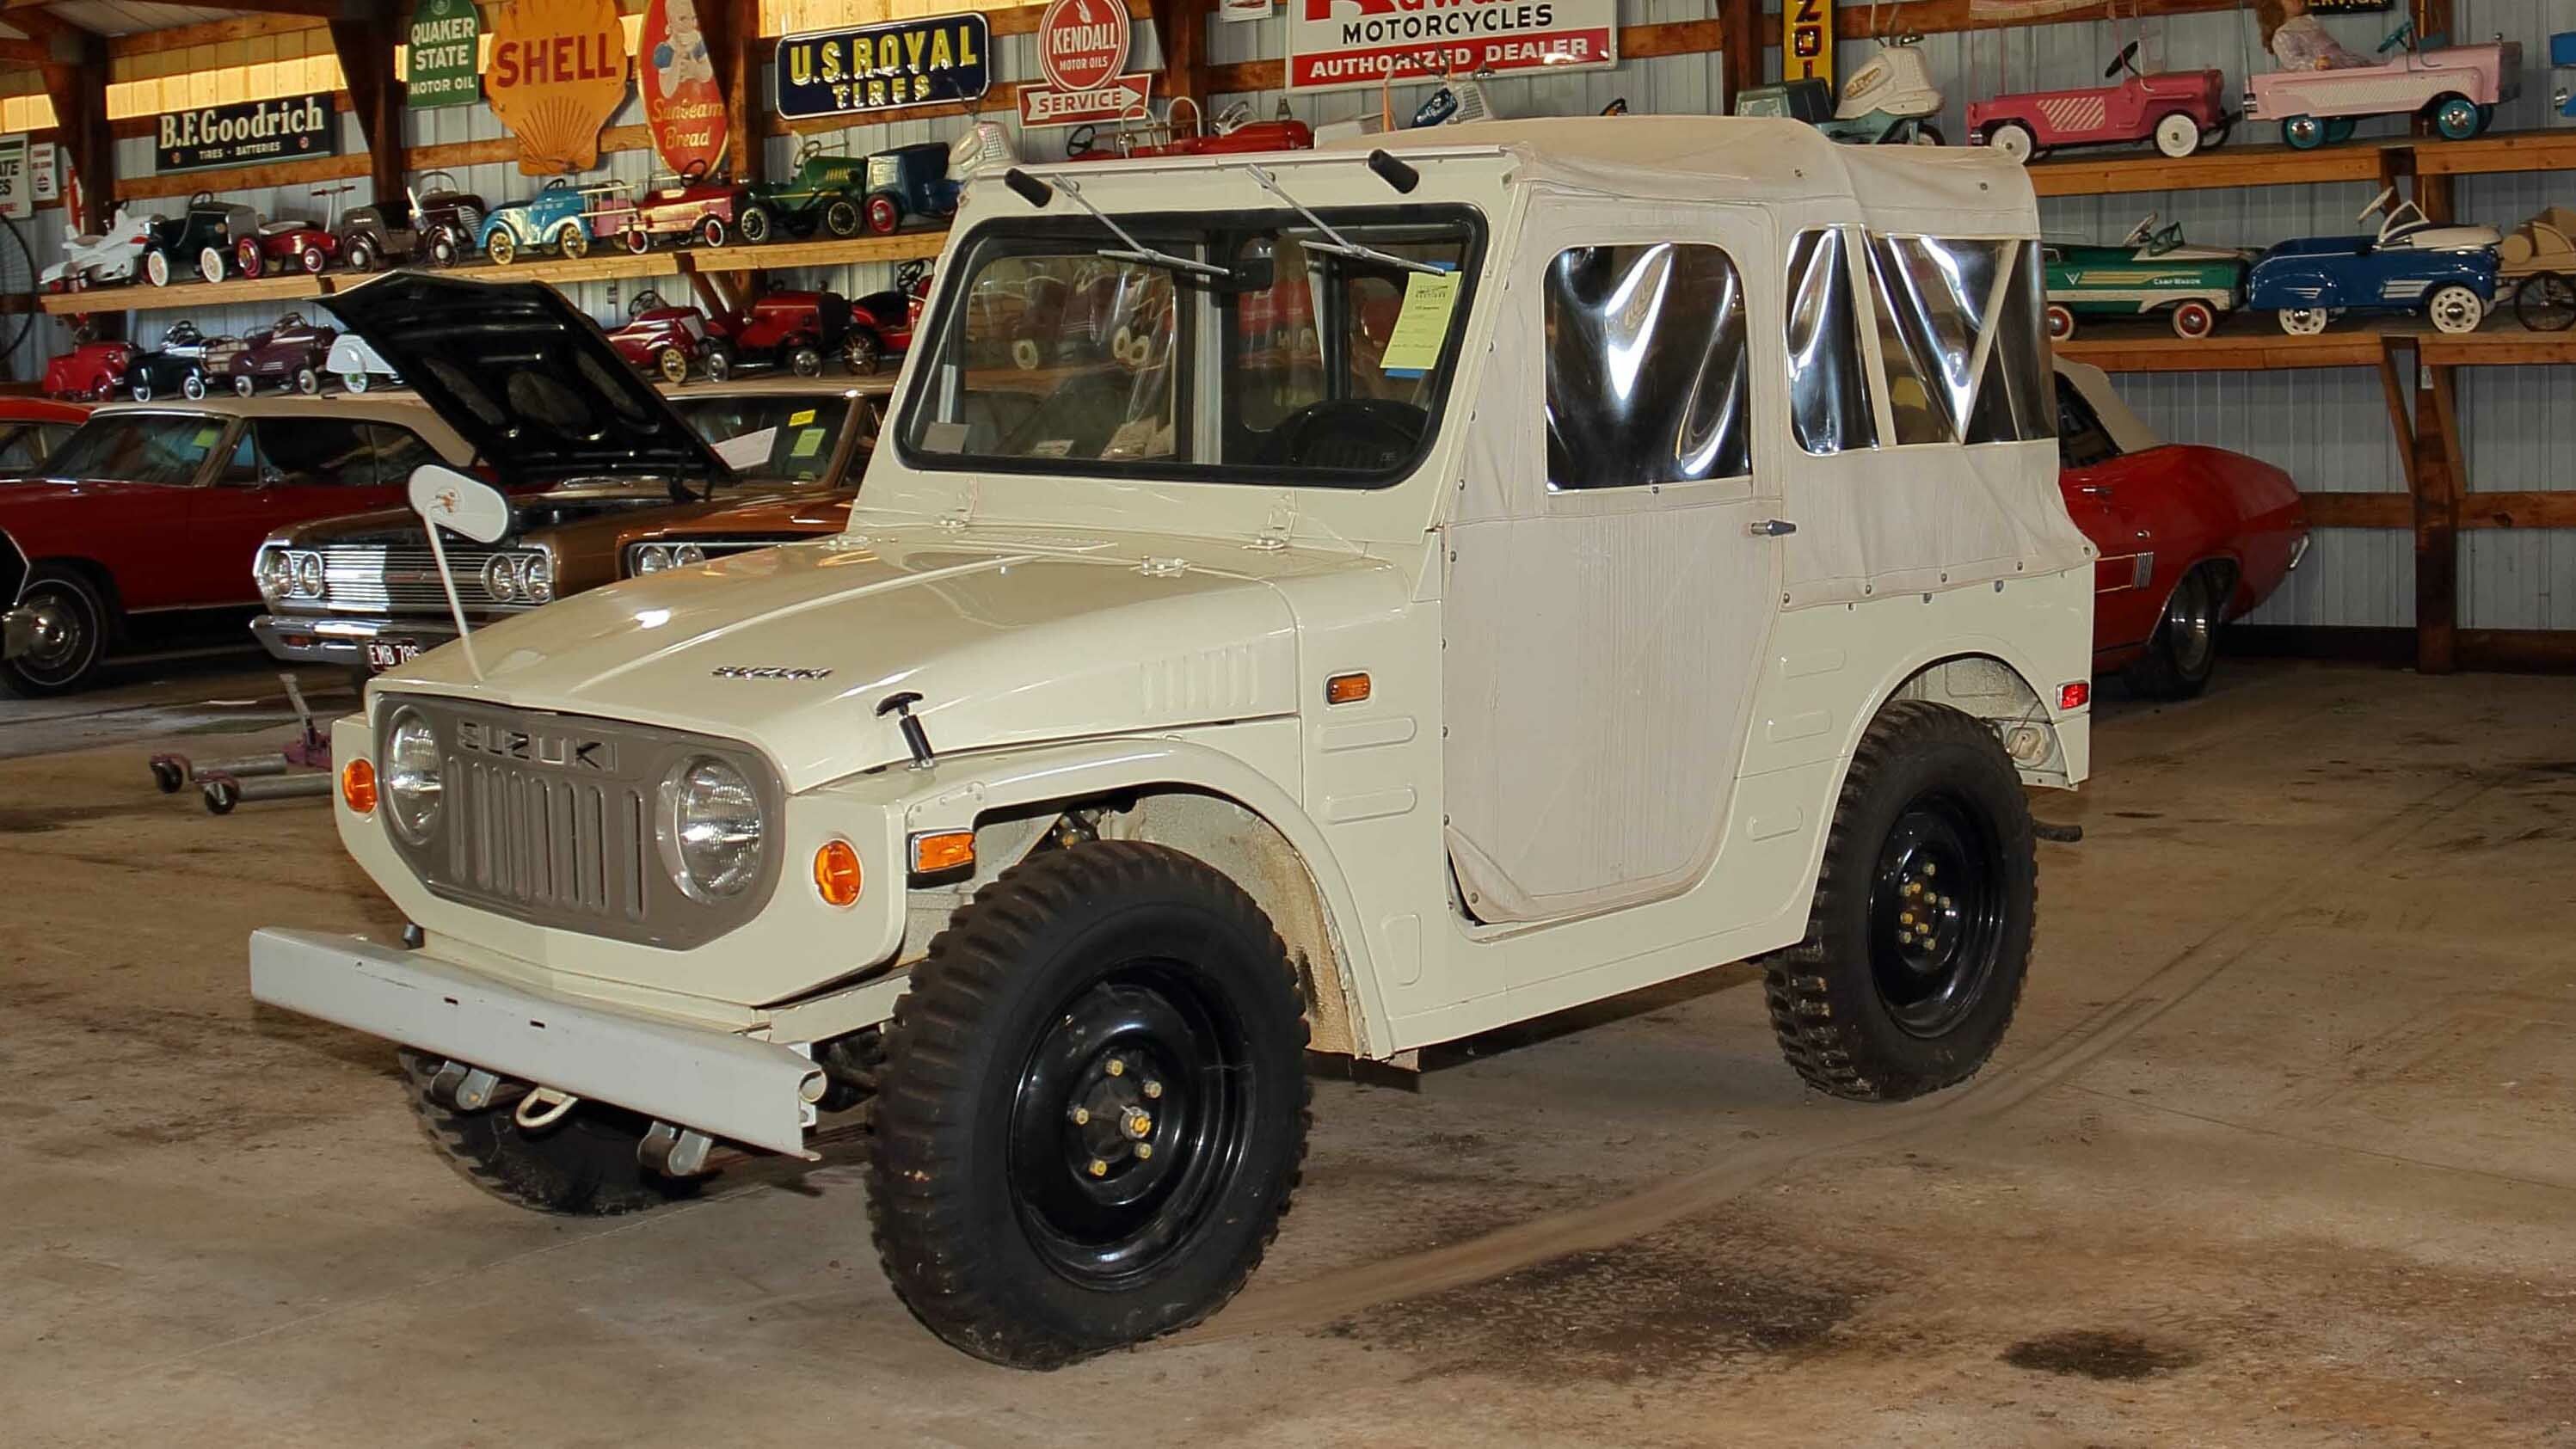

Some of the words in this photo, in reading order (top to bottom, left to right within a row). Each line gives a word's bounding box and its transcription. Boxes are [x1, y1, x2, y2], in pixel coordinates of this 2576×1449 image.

[411, 17, 475, 46] QUAKER
[1342, 3, 1552, 44] MOTORCYCLES
[1053, 22, 1116, 54] KENDALL
[415, 45, 469, 71] STATE
[496, 33, 616, 89] SHELL
[1060, 58, 1087, 71] MOTOR
[1089, 56, 1109, 68] OILS
[1309, 47, 1472, 78] AUTHORIZED
[1485, 38, 1589, 63] DEALER
[410, 79, 450, 95] MOTOR
[454, 76, 475, 89] OIL
[832, 75, 931, 109] TIRES
[652, 98, 724, 122] Sunbeam
[1038, 92, 1122, 113] SERVICE
[199, 148, 224, 160] TIRES
[235, 141, 281, 156] BATTERIES
[664, 126, 711, 150] Bread
[457, 719, 619, 772] SUZUKI
